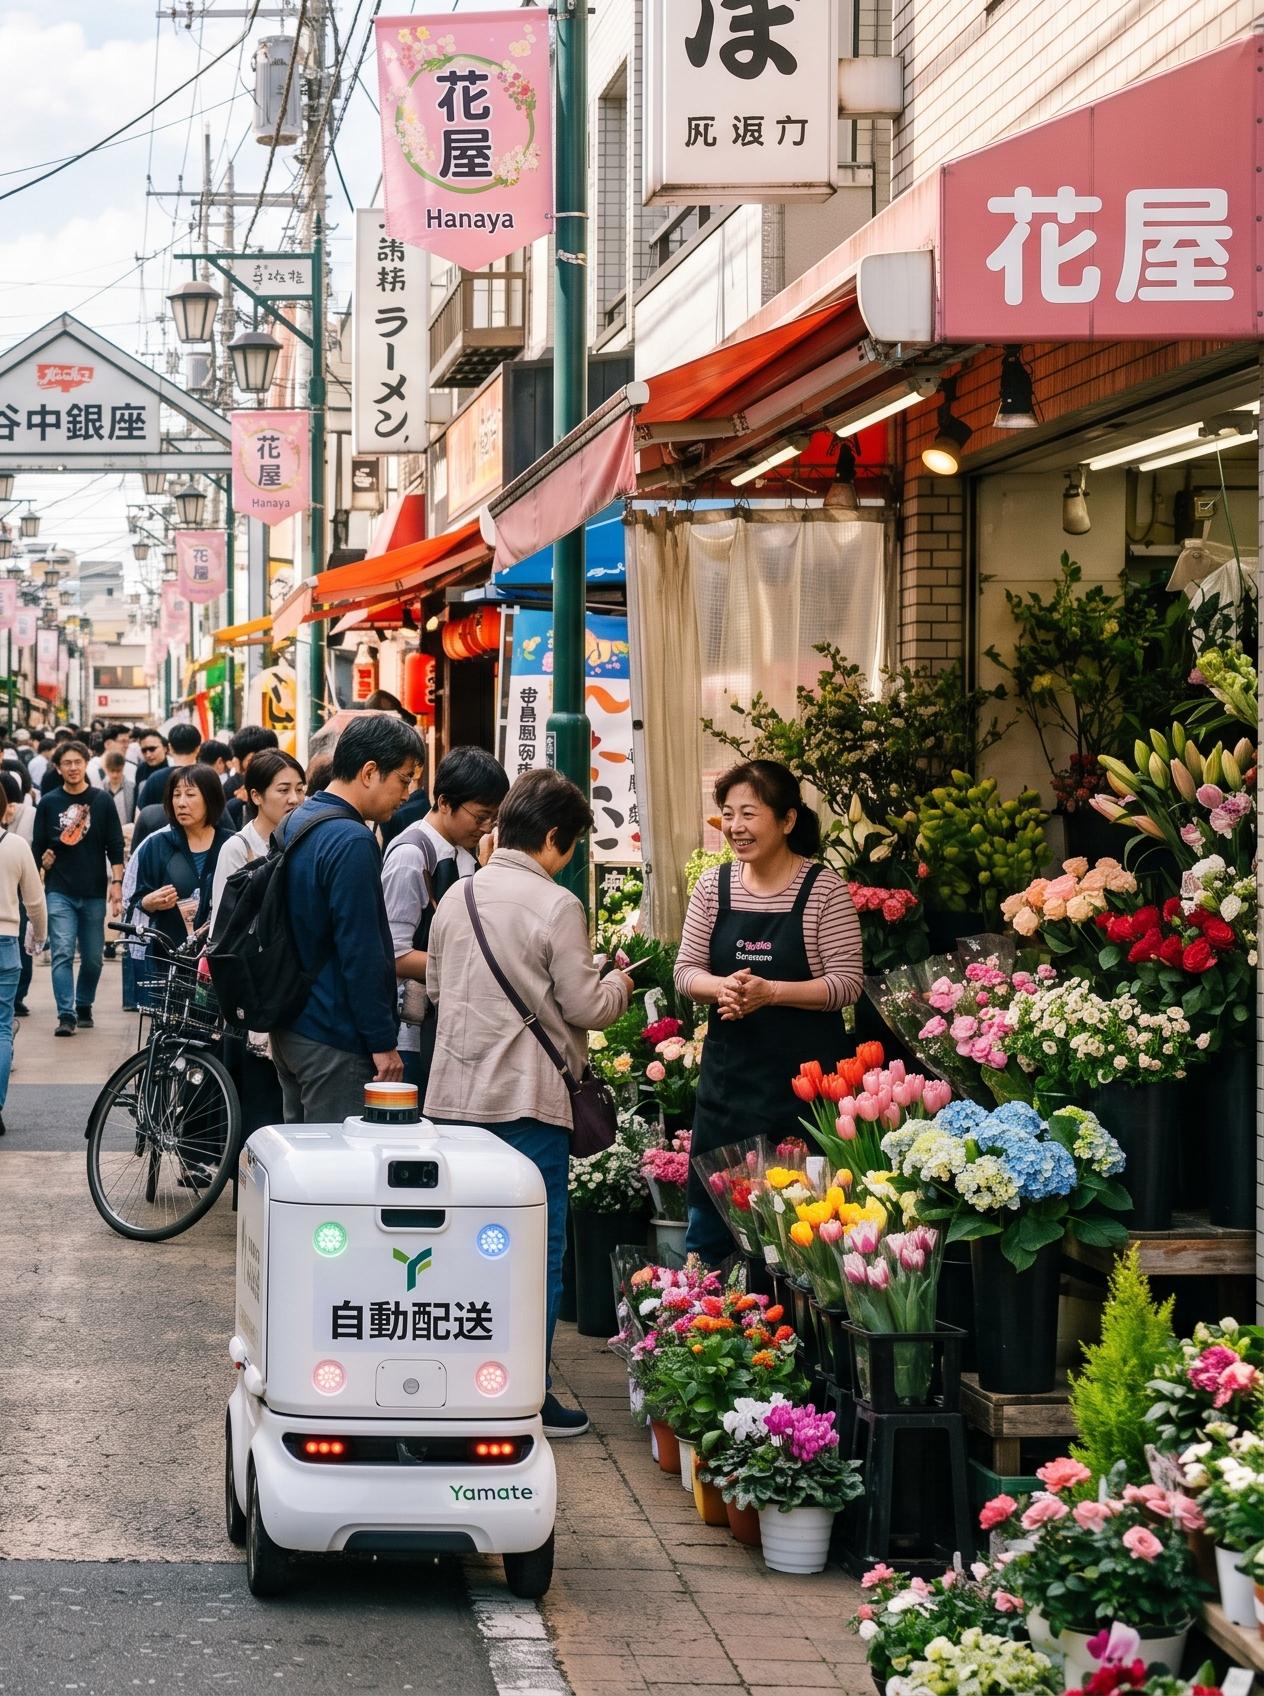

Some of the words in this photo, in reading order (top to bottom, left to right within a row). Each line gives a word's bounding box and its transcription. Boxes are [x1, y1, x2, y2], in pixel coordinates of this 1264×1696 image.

[436, 70, 493, 178] 花屋
[427, 208, 514, 233] Hanaya
[985, 185, 1235, 306] 花屋
[373, 306, 409, 438] ラーメン
[256, 435, 282, 486] 花屋
[252, 499, 290, 510] Hanaya
[330, 1299, 494, 1341] 自動配送
[449, 1484, 533, 1502] Yamate
